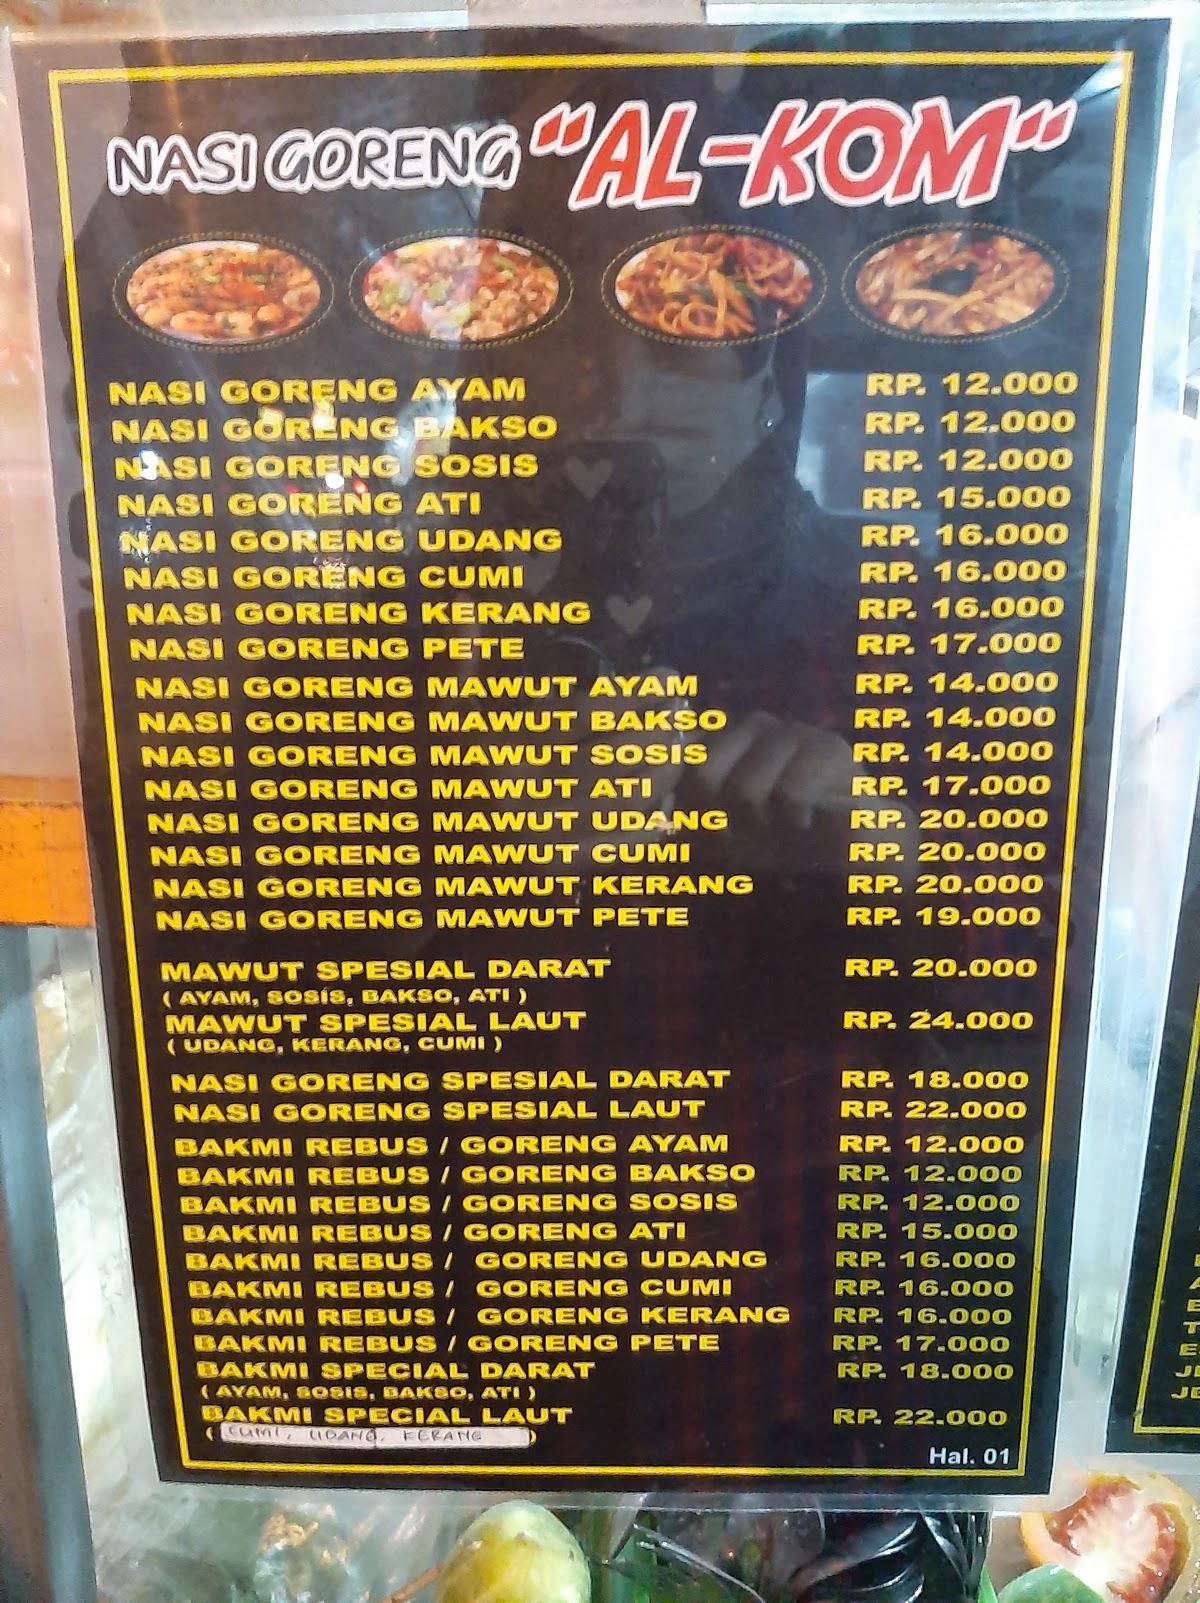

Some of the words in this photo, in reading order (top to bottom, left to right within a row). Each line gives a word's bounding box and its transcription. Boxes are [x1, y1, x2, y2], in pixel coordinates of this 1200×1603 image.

[107, 132, 257, 196] NASI
[264, 124, 521, 193] GORENG
[108, 380, 205, 406] NASI
[221, 378, 398, 405] GORENG
[412, 377, 526, 401] AYAM
[868, 373, 925, 395] RP.
[941, 372, 1077, 395] 12.000
[115, 456, 211, 480] NASI
[225, 455, 397, 480] GORENG
[415, 450, 538, 478] SOSIS
[864, 450, 922, 471] RP.
[938, 449, 1072, 471] 12.000
[118, 493, 213, 517] NASI
[227, 491, 401, 517] GORENG
[416, 492, 481, 515] ATI
[863, 488, 921, 508] RP.
[937, 486, 1070, 509] 15.000
[121, 530, 216, 553] NASI
[230, 529, 404, 553] GORENG
[419, 528, 562, 552] UDANG
[862, 525, 918, 547] RP.
[936, 523, 1068, 546] 16.000
[124, 566, 218, 590] NASI
[233, 565, 406, 589] GORENG
[419, 565, 523, 589] CUMI
[860, 561, 919, 583] RP.
[934, 560, 1066, 582] 16.000
[127, 602, 221, 625] NASI
[235, 602, 407, 625] GORENG
[422, 601, 591, 624] KERANG
[859, 598, 917, 620] RP.
[932, 596, 1064, 619] 16.000
[129, 637, 224, 661] NASI
[238, 638, 409, 660] GORENG
[423, 637, 524, 660] PETE
[857, 634, 915, 656] RP.
[928, 632, 1061, 654] 17.000
[135, 677, 229, 700] NASI
[243, 676, 413, 699] GORENG
[427, 676, 576, 698] MAWUT
[589, 675, 698, 698] AYAM
[856, 673, 914, 694] RP.
[926, 672, 1058, 693] 14.000
[138, 712, 232, 735] NASI
[246, 711, 415, 733] GORENG
[429, 711, 577, 732] MAWUT
[591, 709, 727, 732] BAKSO
[854, 708, 912, 729] RP.
[925, 706, 1056, 728] 14.000
[144, 780, 236, 801] NASI
[251, 779, 418, 800] GORENG
[432, 778, 579, 799] MAWUT
[591, 777, 651, 799] ATI
[852, 776, 907, 796] RP.
[924, 775, 1051, 796] 17.000
[147, 813, 239, 834] NASI
[253, 812, 419, 833] GORENG
[433, 811, 579, 832] MAWUT
[592, 810, 728, 832] UDANG
[851, 809, 905, 830] RP.
[920, 808, 1048, 829] 20.000
[153, 878, 243, 899] NASI
[257, 877, 422, 898] GORENG
[435, 876, 580, 897] MAWUT
[593, 875, 753, 895] KERANG
[848, 875, 902, 894] RP.
[916, 874, 1043, 894] 20.000
[156, 910, 246, 931] NASI
[259, 909, 423, 930] GORENG
[437, 908, 580, 928] MAWUT
[593, 907, 688, 927] PETE
[847, 907, 901, 926] RP.
[917, 906, 1041, 926] 19.000
[161, 962, 304, 982] MAWUT
[317, 960, 475, 981] SPESIAL
[488, 959, 611, 979] DARAT
[845, 959, 898, 977] RP.
[912, 959, 1037, 977] 20.000
[180, 990, 259, 1007] AYAM,
[267, 990, 353, 1006] SOSIS,
[362, 989, 460, 1005] BAKSO,
[469, 988, 510, 1002] ATI
[166, 1014, 305, 1034] MAWUT
[320, 1013, 476, 1033] SPESIAL
[490, 1011, 586, 1031] LAUT
[844, 1011, 896, 1029] RP.
[911, 1010, 1033, 1030] 24.000
[184, 1038, 283, 1055] UDANG,
[292, 1037, 409, 1053] KERANG,
[418, 1036, 484, 1051] CUMI
[171, 1074, 258, 1094] NASI
[271, 1072, 429, 1093] GORENG
[442, 1071, 597, 1091] SPESIAL
[610, 1070, 730, 1089] DARAT
[842, 1071, 893, 1088] RP.
[909, 1071, 1029, 1089] 18.000
[174, 1104, 260, 1123] NASI
[273, 1102, 430, 1123] GORENG
[443, 1101, 597, 1121] SPESIAL
[610, 1100, 705, 1119] LAUT
[841, 1100, 892, 1118] RP.
[906, 1101, 1027, 1119] 22.000
[175, 1138, 292, 1157] BAKMI
[306, 1137, 428, 1157] REBUS
[440, 1137, 449, 1155] /
[461, 1135, 616, 1155] GORENG
[628, 1135, 728, 1153] AYAM
[840, 1135, 890, 1153] RP.
[906, 1135, 1024, 1153] 12.000
[177, 1168, 294, 1186] BAKMI
[308, 1166, 429, 1186] REBUS
[442, 1167, 450, 1184] /
[462, 1164, 616, 1184] GORENG
[630, 1164, 755, 1182] BAKSO
[839, 1165, 889, 1181] RP.
[904, 1165, 1023, 1183] 12.000
[183, 1225, 298, 1243] BAKMI
[312, 1224, 432, 1243] REBUS
[444, 1222, 452, 1241] /
[464, 1222, 617, 1241] GORENG
[629, 1222, 685, 1241] ATI
[837, 1223, 886, 1239] RP.
[902, 1223, 1019, 1240] 15.000
[194, 1335, 306, 1353] BAKMI
[320, 1336, 436, 1353] REBUS
[448, 1335, 457, 1351] /
[468, 1335, 618, 1352] GORENG
[631, 1334, 719, 1351] PETE
[833, 1335, 881, 1351] RP.
[896, 1335, 1011, 1352] 17.000
[197, 1361, 308, 1379] BAKMI
[321, 1362, 468, 1380] SPECIAL
[481, 1362, 593, 1379] DARAT
[838, 1363, 886, 1378] RP.
[901, 1363, 1013, 1380] 18.000
[216, 1386, 288, 1401] AYAM,
[297, 1386, 374, 1401] SOSIS,
[383, 1386, 473, 1401] BAKSO,
[482, 1387, 520, 1399] ATI
[201, 1405, 312, 1424] BAKMI
[324, 1408, 470, 1424] SPECIAL
[482, 1408, 572, 1424] LAUT
[834, 1408, 882, 1424] RP.
[894, 1410, 1007, 1425] 22.000
[928, 1447, 975, 1466] Hal.
[983, 1447, 1010, 1466] 01
